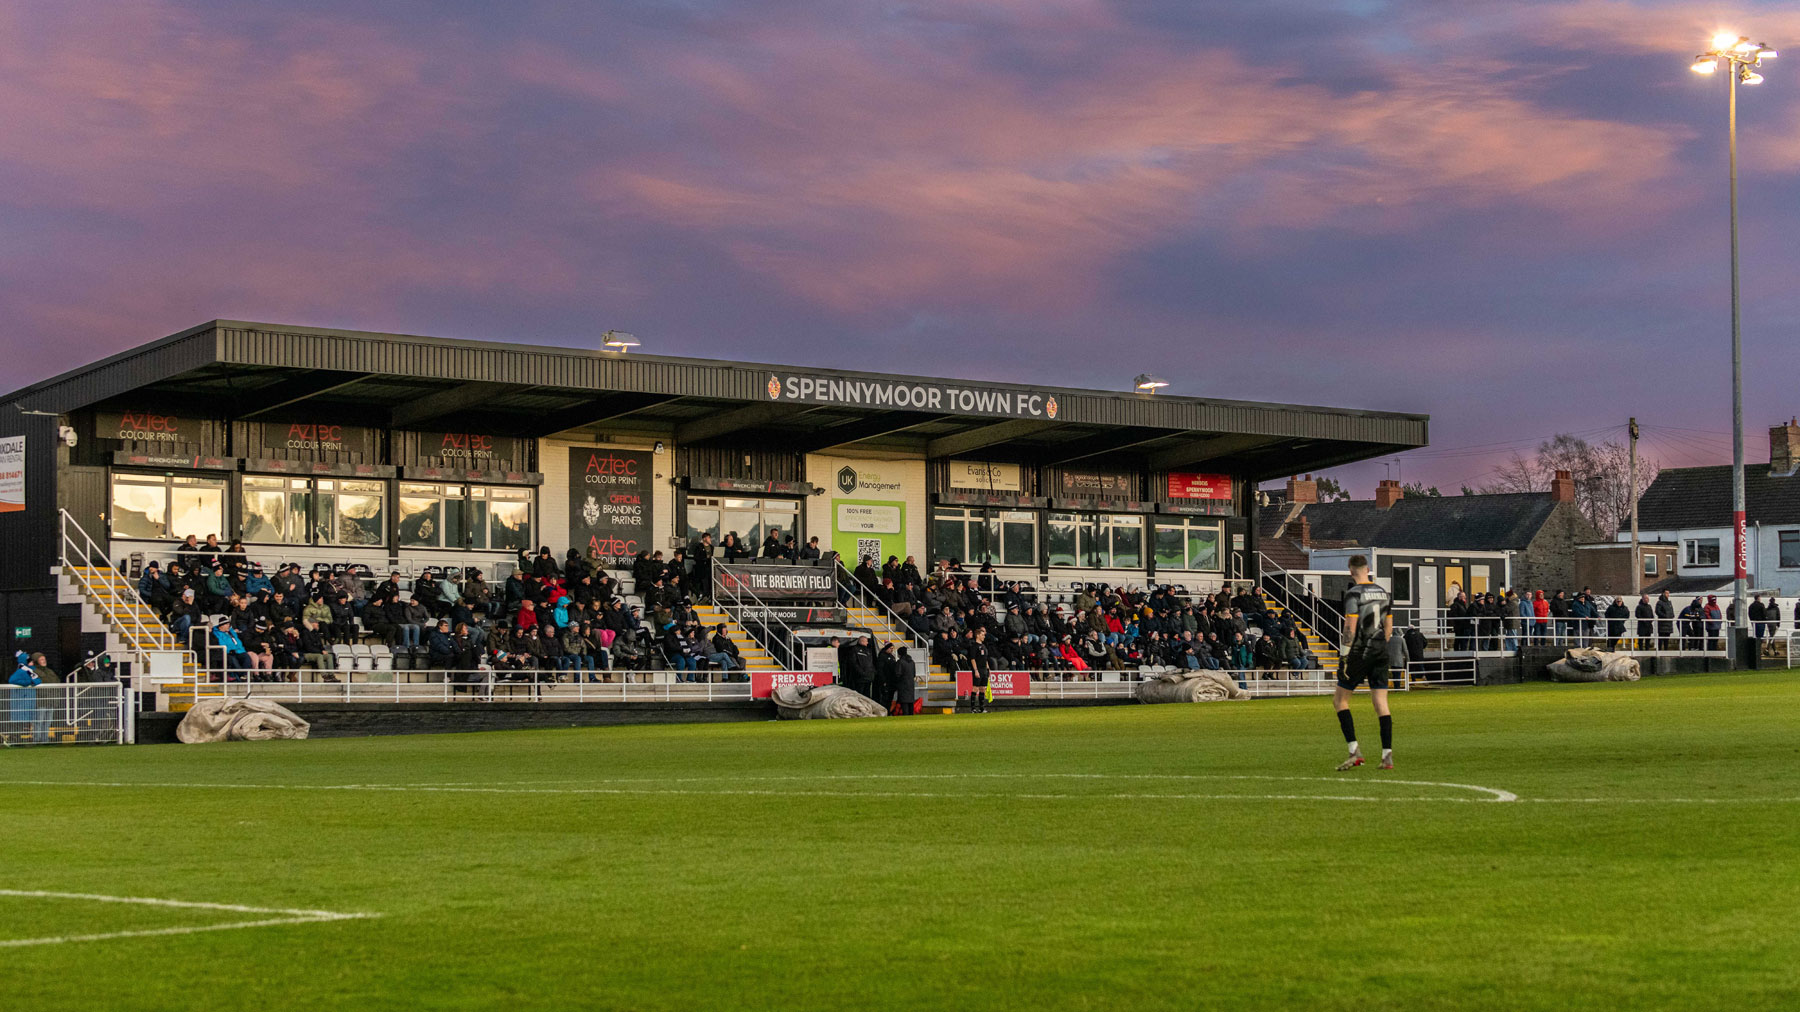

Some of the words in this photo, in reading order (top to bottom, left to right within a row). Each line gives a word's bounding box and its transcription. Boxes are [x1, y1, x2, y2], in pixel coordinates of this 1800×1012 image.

[786, 377, 941, 409] SPENNYMOOR
[947, 389, 1010, 413] TOWN
[1017, 394, 1042, 415] FC
[120, 412, 178, 431] Aztec
[119, 430, 155, 441] COLOUR
[156, 431, 178, 441] PRINT
[288, 424, 342, 441] Aztec
[287, 440, 319, 449] COLOUR
[321, 441, 342, 450] PRINT
[441, 433, 492, 449] Aztec
[441, 448, 472, 458] COLOUR
[473, 450, 492, 459] PRINT
[586, 453, 638, 475] Aztec
[859, 471, 881, 482] Energy
[967, 465, 986, 476] Evans
[992, 467, 1001, 477] Co
[585, 475, 617, 484] COLOUR
[618, 476, 638, 485] PRINT
[841, 475, 853, 486] UK
[859, 481, 901, 492] Management
[610, 494, 641, 504] OFFICIAL
[603, 505, 641, 515] BRANDING
[612, 516, 641, 525] PARTNER
[589, 535, 638, 556] Aztec
[1739, 520, 1747, 570] Crimzon
[721, 573, 740, 587] THIS
[741, 574, 750, 587] IS
[751, 574, 768, 588] THE
[769, 575, 808, 589] BREWERY
[809, 575, 832, 589] FIELD
[1373, 603, 1381, 629] 1
[778, 674, 796, 683] RED
[797, 674, 814, 683] SKY
[997, 674, 1013, 682] SKY
